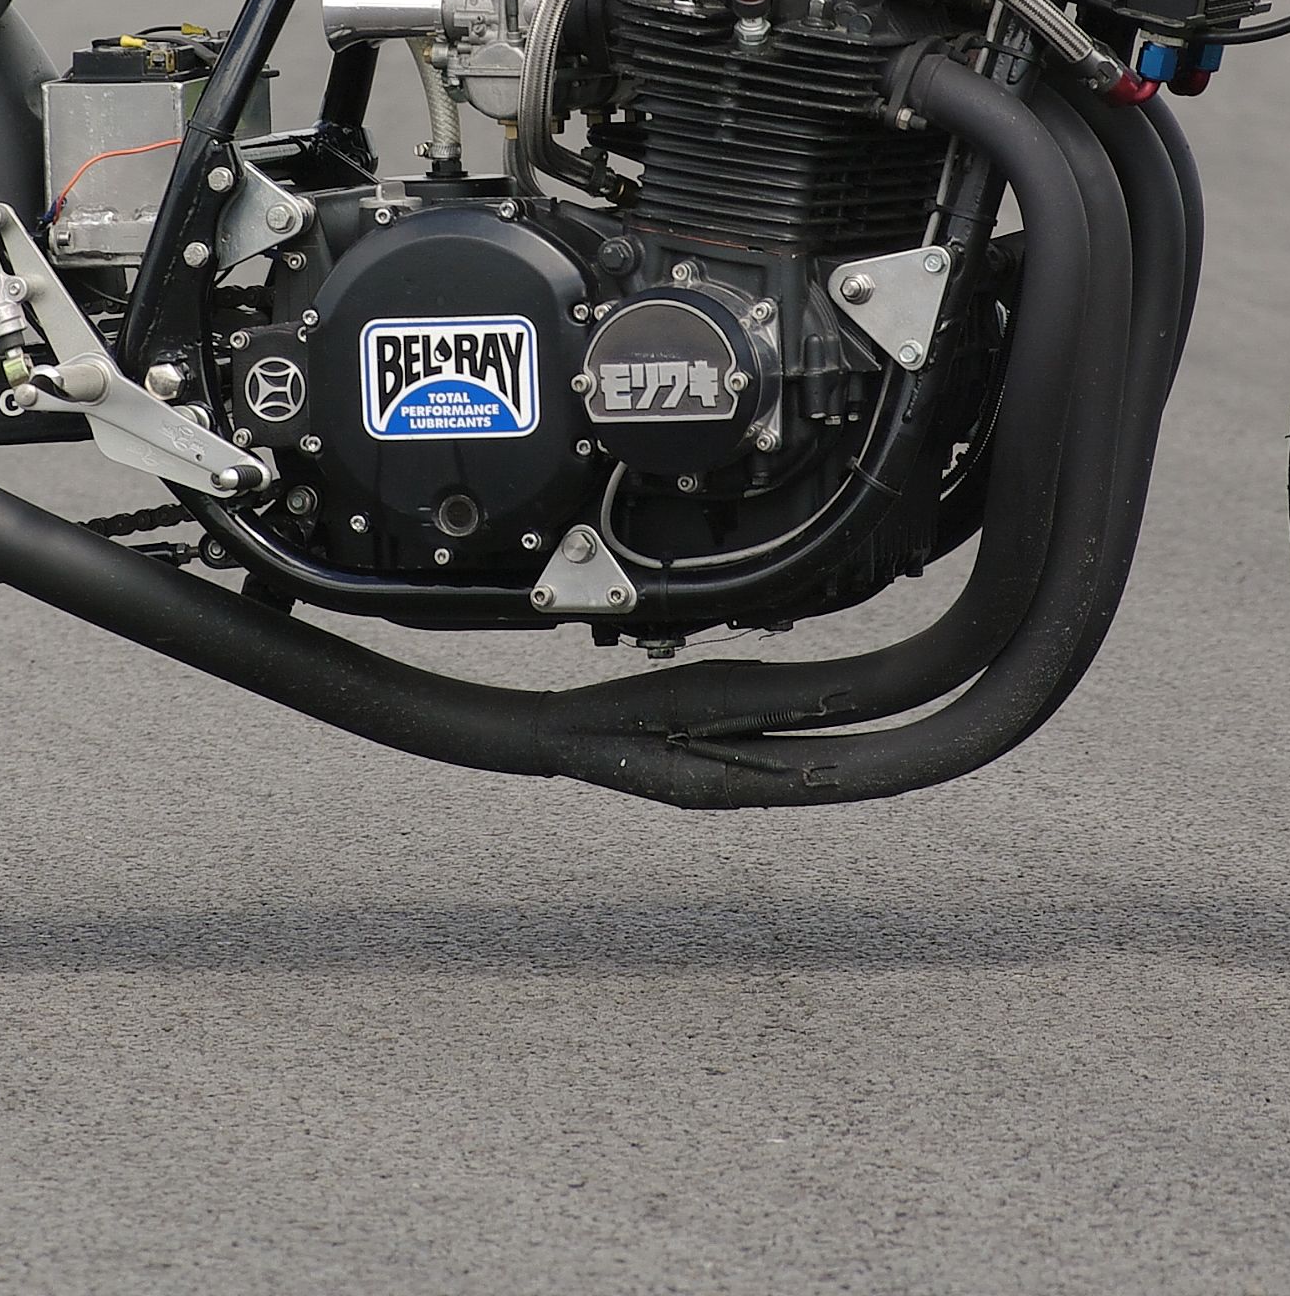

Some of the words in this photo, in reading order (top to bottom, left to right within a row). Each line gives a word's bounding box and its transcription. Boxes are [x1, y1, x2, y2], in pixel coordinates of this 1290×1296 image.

[599, 360, 719, 410] モリワキ
[427, 392, 471, 404] TOTAL
[400, 404, 500, 417] PERFORMANCE
[409, 417, 492, 429] LUBRICANTS
